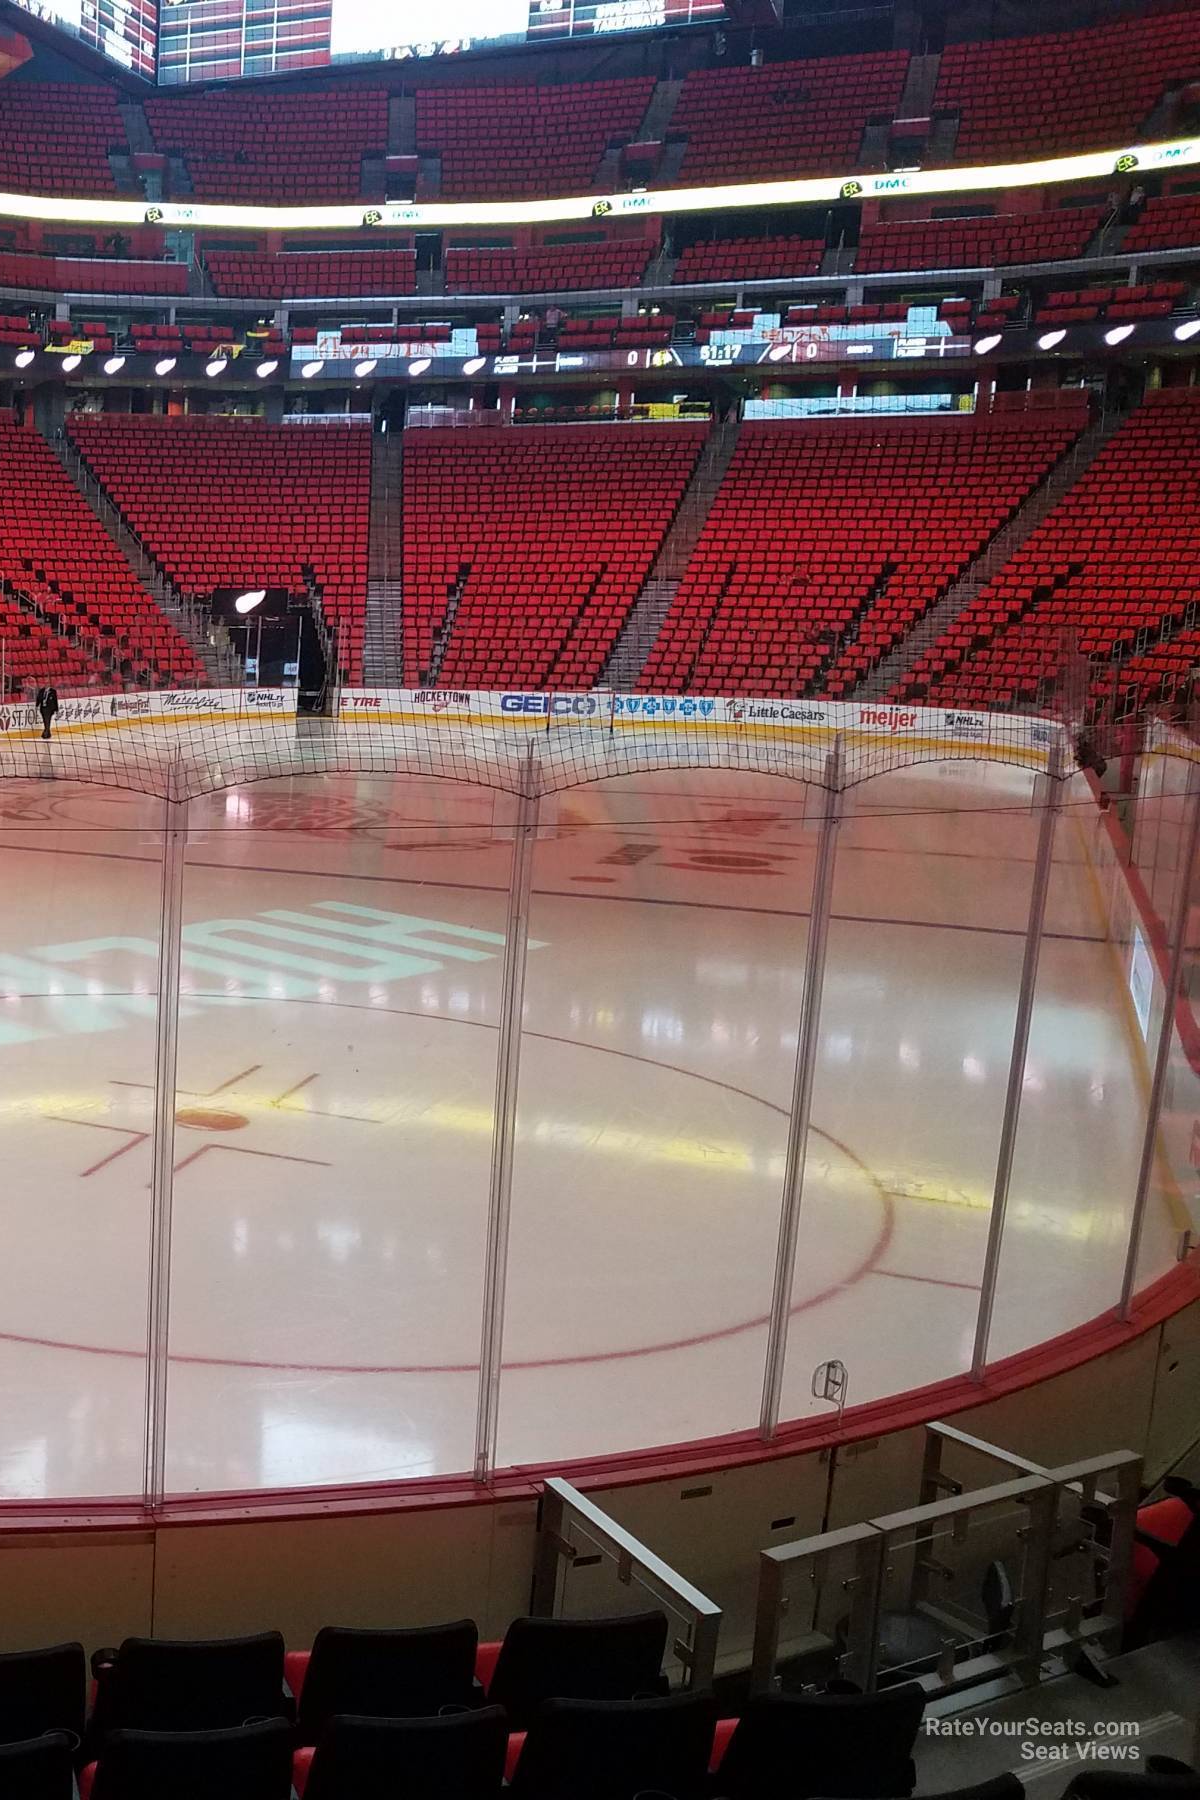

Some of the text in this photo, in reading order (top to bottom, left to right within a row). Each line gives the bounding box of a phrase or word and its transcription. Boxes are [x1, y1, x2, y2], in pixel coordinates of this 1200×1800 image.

[353, 697, 382, 707] TIRE
[414, 691, 471, 706] HOCKEYTOWN
[500, 695, 596, 715] GEICO
[748, 705, 825, 722] Little Caesars
[859, 707, 918, 730] meijer
